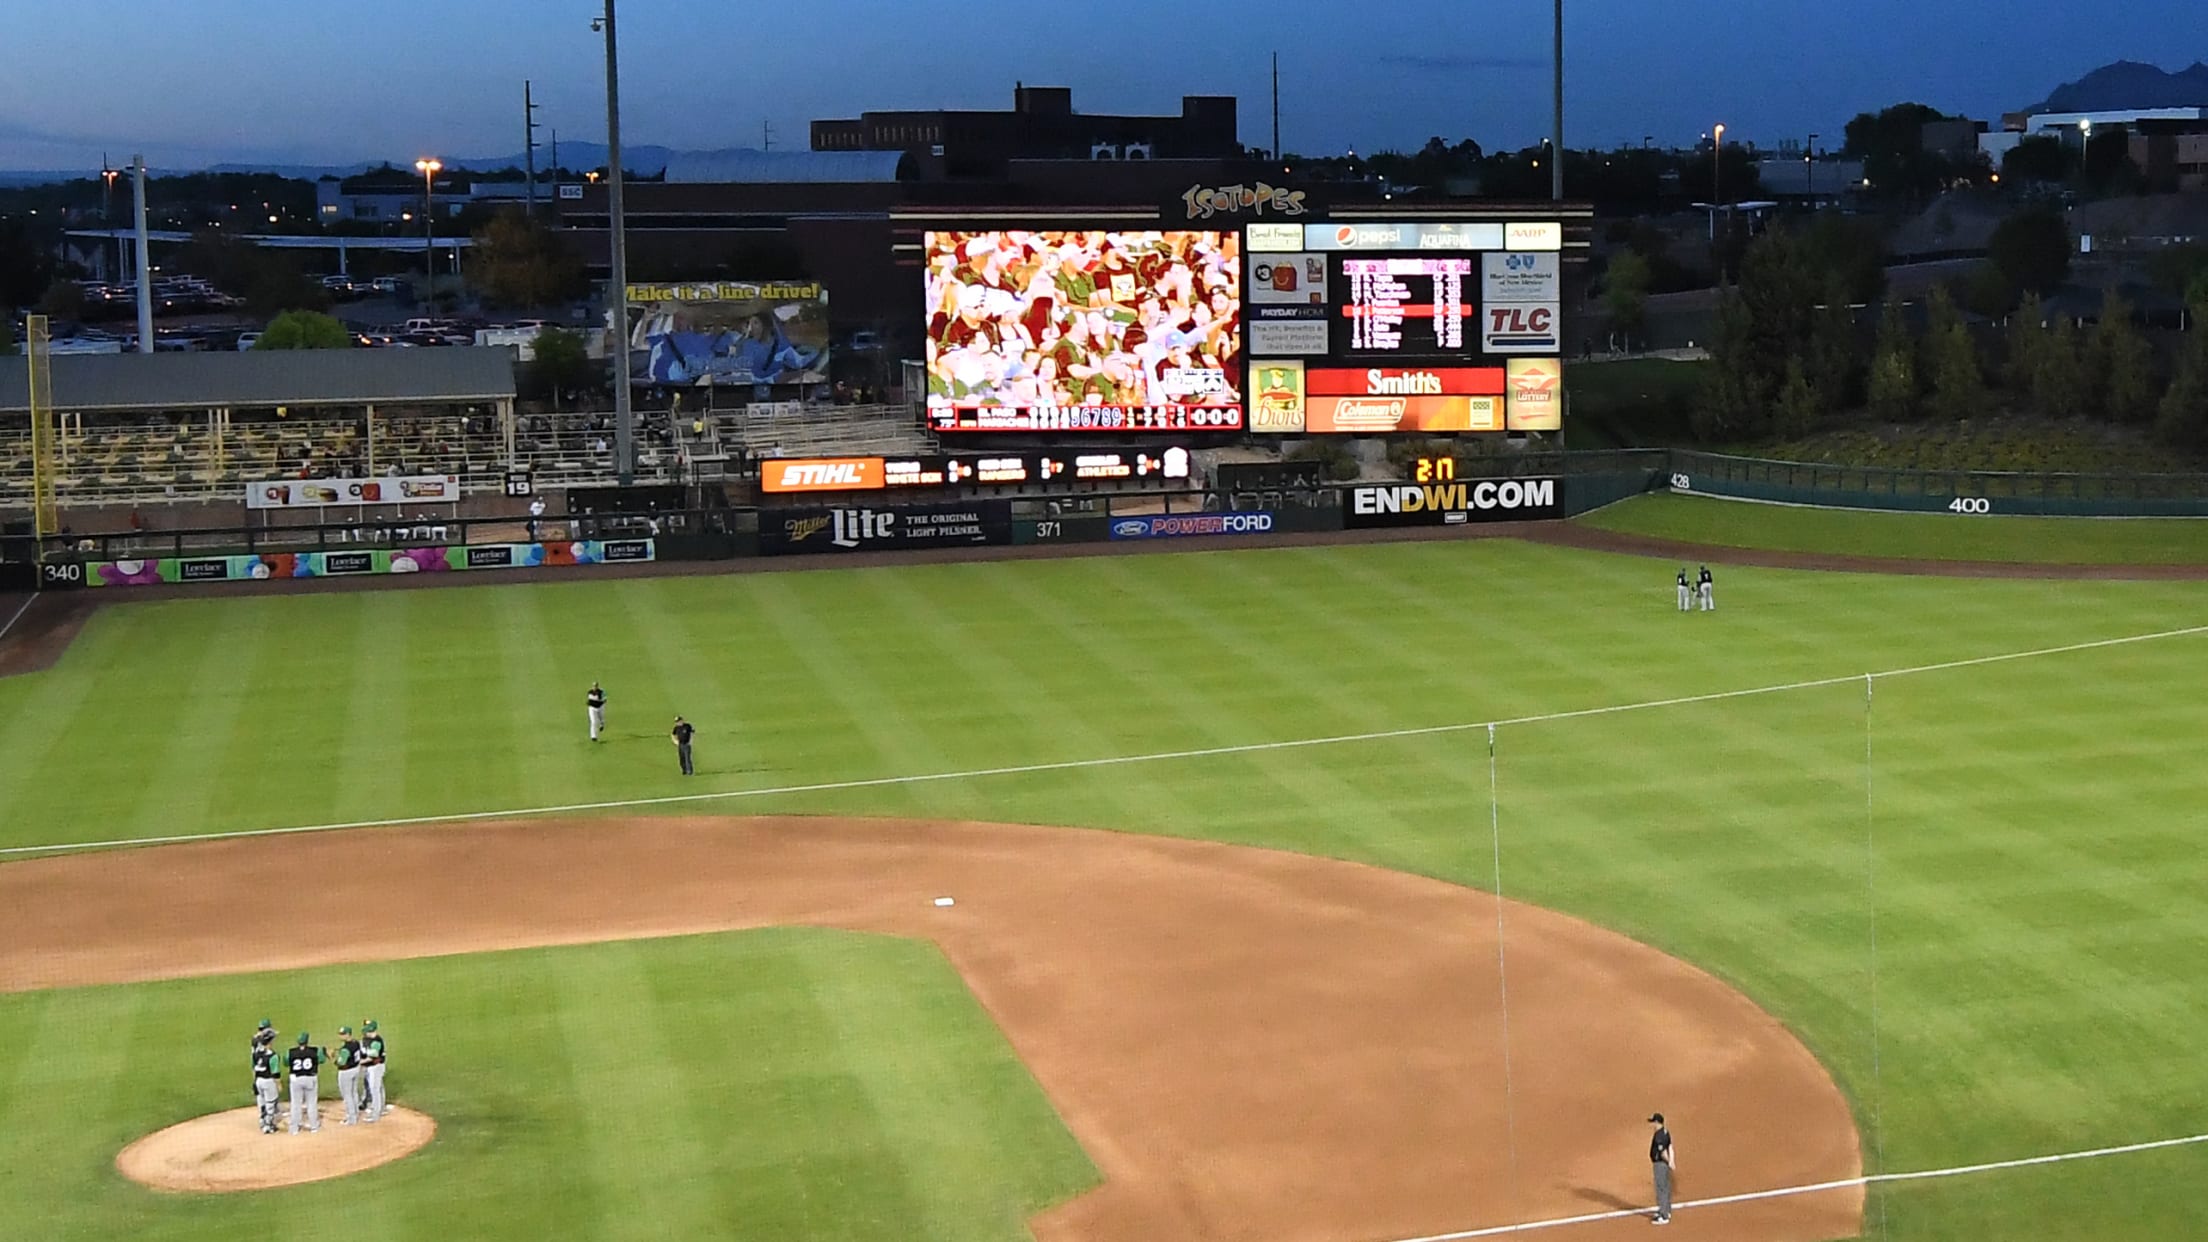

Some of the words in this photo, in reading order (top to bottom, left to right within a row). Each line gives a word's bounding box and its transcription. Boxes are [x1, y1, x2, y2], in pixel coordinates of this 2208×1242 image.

[1182, 181, 1306, 219] ISOTOPES
[1360, 228, 1400, 245] pepsi
[679, 285, 694, 300] it
[699, 286, 713, 300] a
[718, 283, 755, 299] line
[760, 283, 819, 299] drive!
[1261, 308, 1298, 317] PAYDAY
[1490, 308, 1551, 332] TLC
[1367, 368, 1442, 395] Smith's
[781, 464, 862, 486] STIHL
[1416, 457, 1454, 482] 2:17
[507, 482, 530, 495] 19
[1671, 473, 1690, 489] 428
[1354, 480, 1554, 515] ENDWI.COM
[1949, 498, 1989, 513] 400
[906, 516, 927, 525] THE
[931, 513, 979, 524] ORIGINAL
[785, 515, 832, 542] Miller
[831, 509, 896, 548] Lite
[906, 528, 935, 537] LIGHT
[1037, 522, 1061, 537] 371
[45, 564, 80, 581] 340
